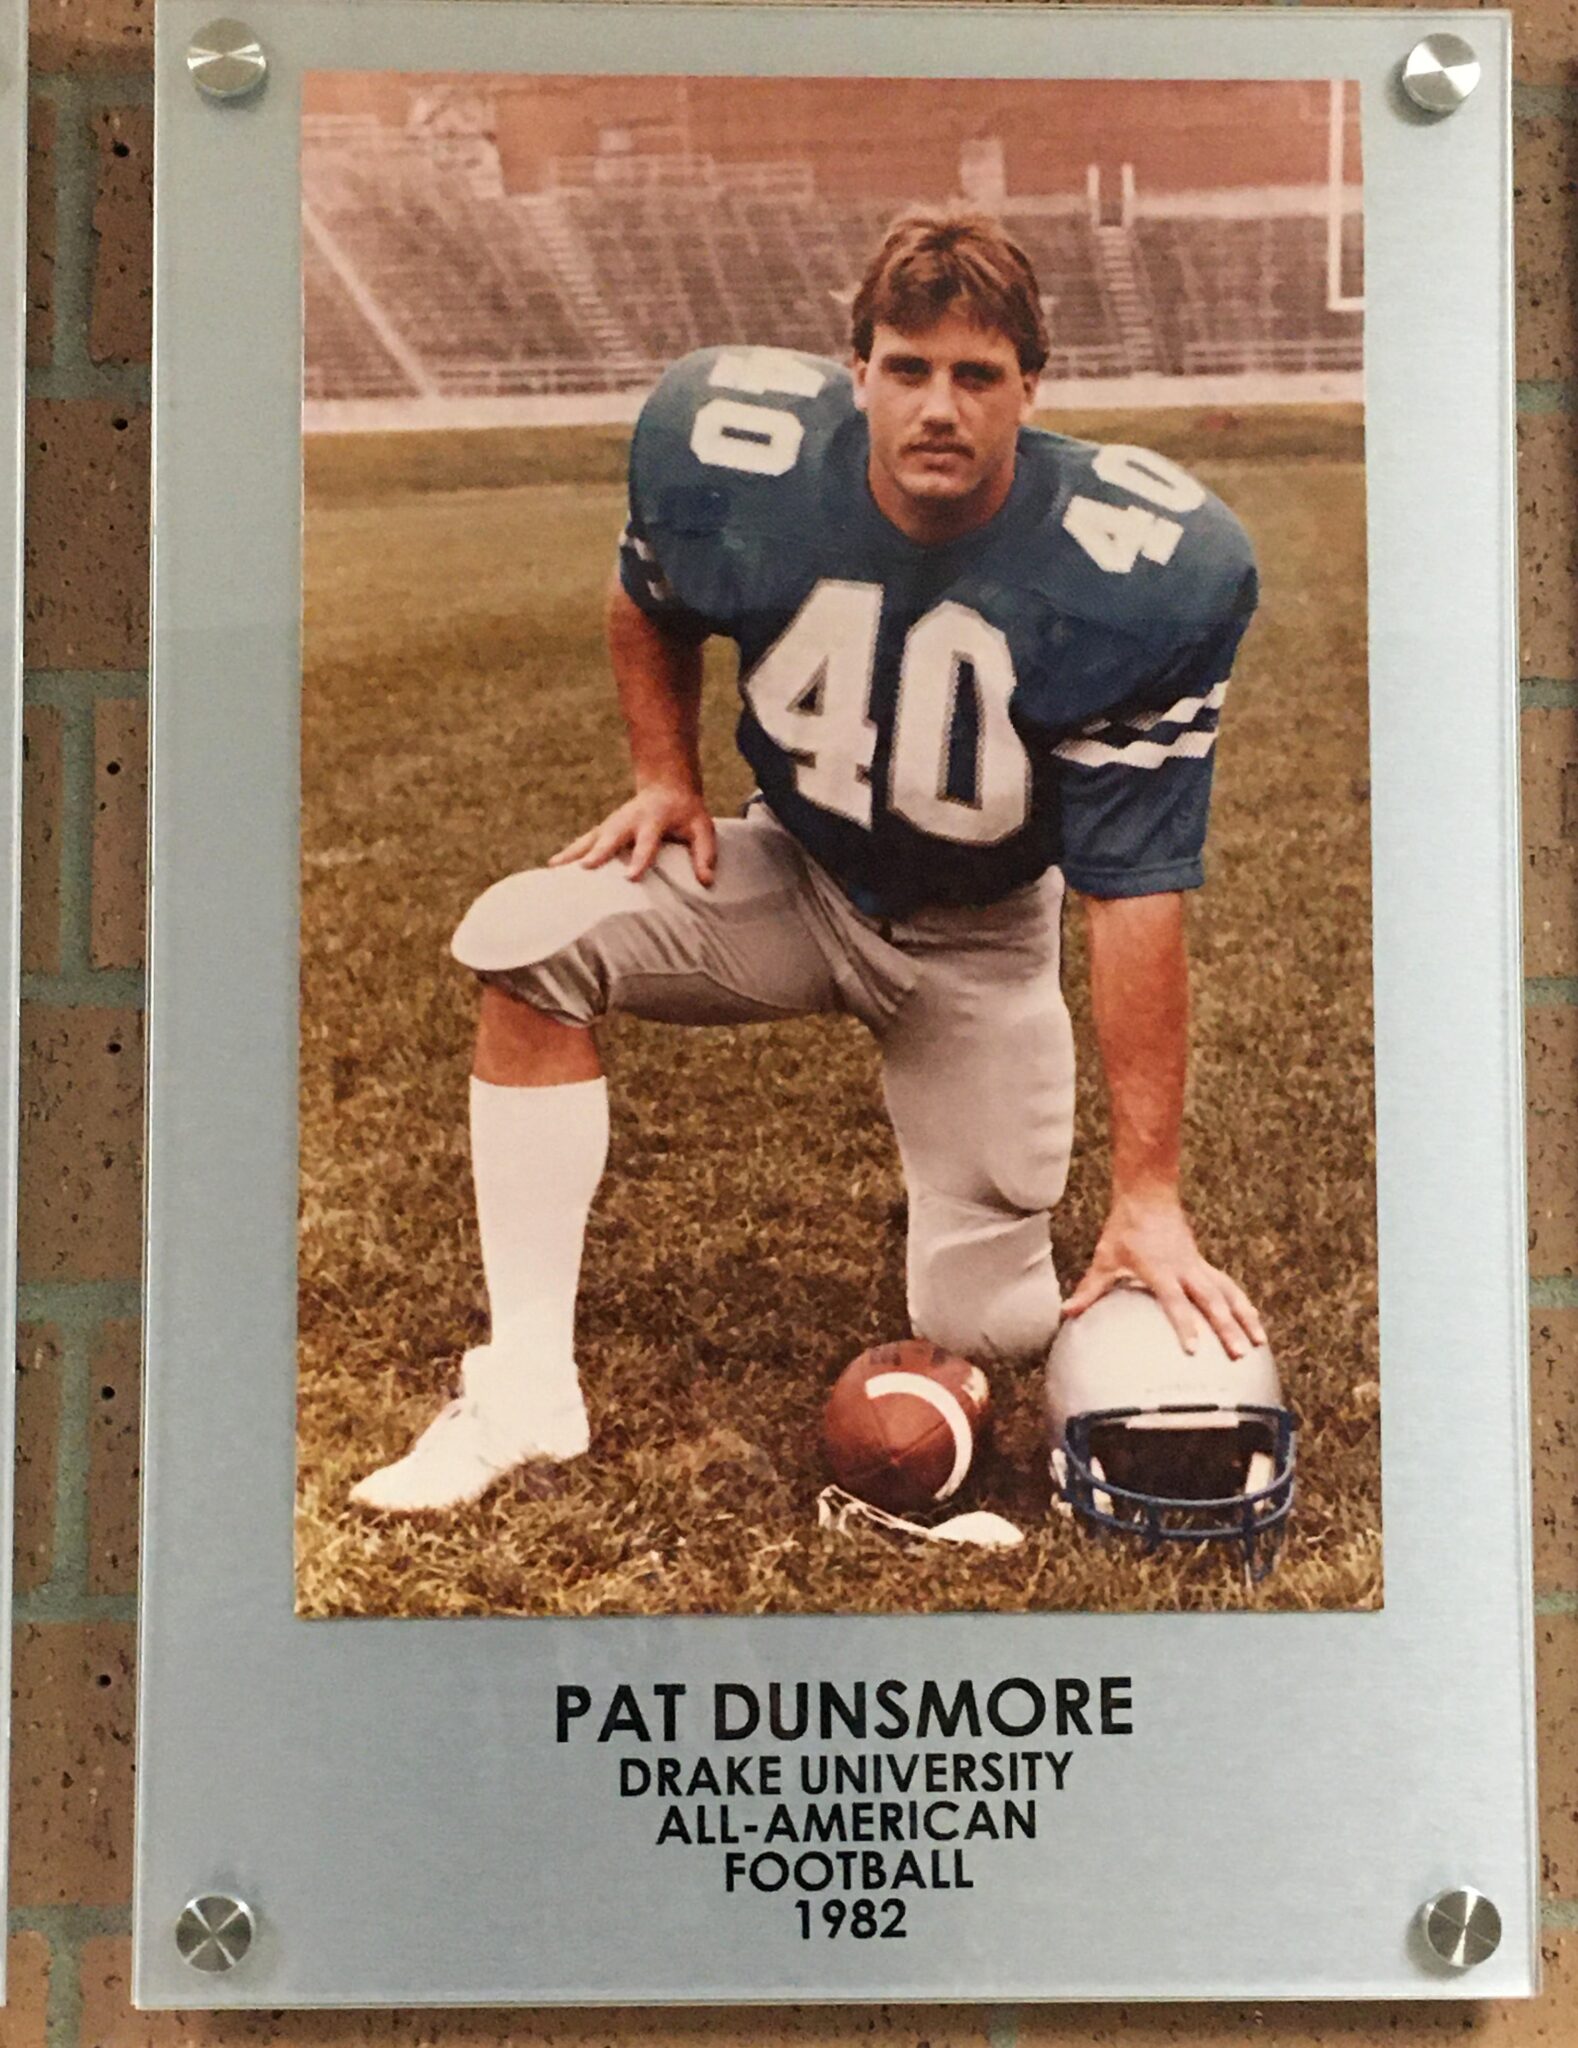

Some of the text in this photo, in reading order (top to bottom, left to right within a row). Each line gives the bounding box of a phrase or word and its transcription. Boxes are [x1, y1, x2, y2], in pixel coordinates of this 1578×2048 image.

[1060, 443, 1207, 574] 40
[742, 576, 1034, 847] 40
[556, 1676, 1133, 1744] PAT DUNSMORE
[619, 1750, 1074, 1798] DRAKE UNIVERSITY
[655, 1799, 1036, 1846] ALL-AMERICAN
[725, 1848, 974, 1893] FOOTBALL
[795, 1897, 907, 1940] 1982
